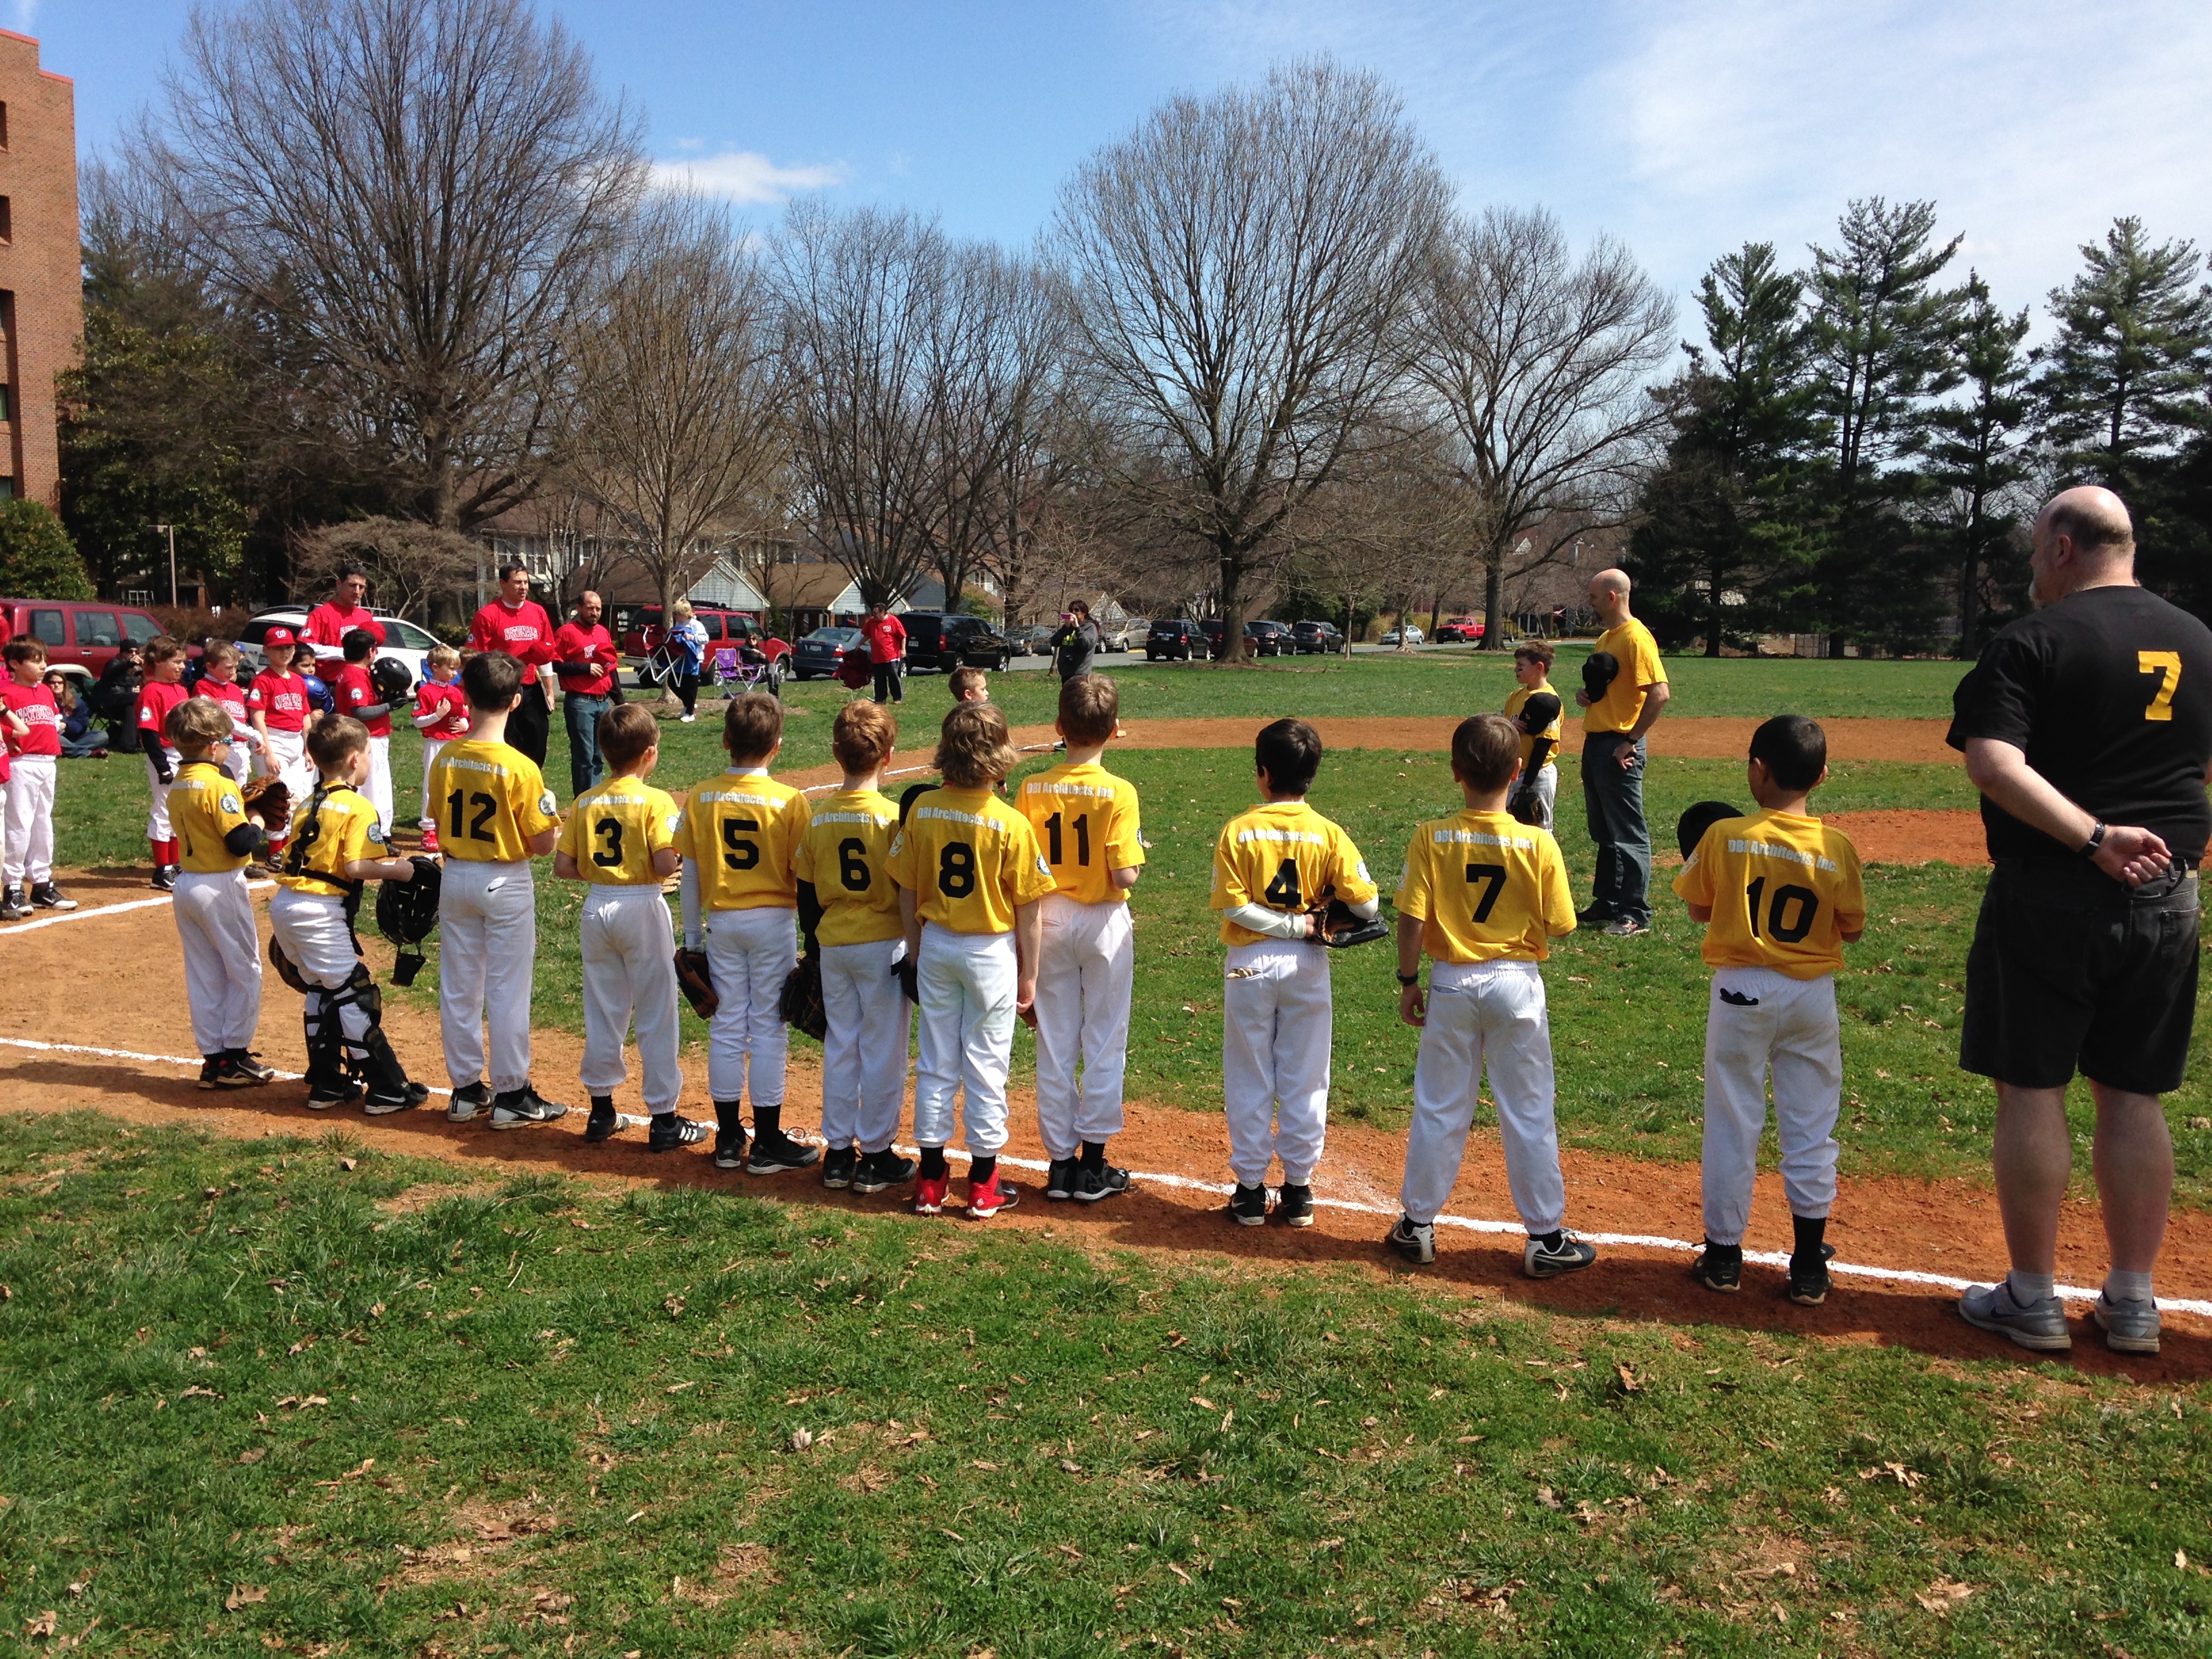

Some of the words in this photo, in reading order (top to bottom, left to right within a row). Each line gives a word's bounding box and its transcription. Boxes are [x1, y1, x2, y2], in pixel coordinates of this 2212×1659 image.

[504, 626, 539, 640] NATIONALS
[2138, 651, 2182, 720] 7
[447, 789, 497, 843] 12
[1042, 781, 1095, 798] Architects,
[593, 817, 623, 867] 3
[932, 806, 985, 827] Architects,
[1044, 812, 1090, 867] 11
[724, 818, 760, 870] 5
[838, 838, 872, 892] 6
[939, 841, 975, 899] 8
[1728, 839, 1748, 853] DBI
[1749, 840, 1815, 868] Architects,
[1816, 855, 1837, 873] Inc.
[1265, 858, 1302, 909] 4
[1466, 863, 1507, 923] 7
[1746, 876, 1820, 943] 10
